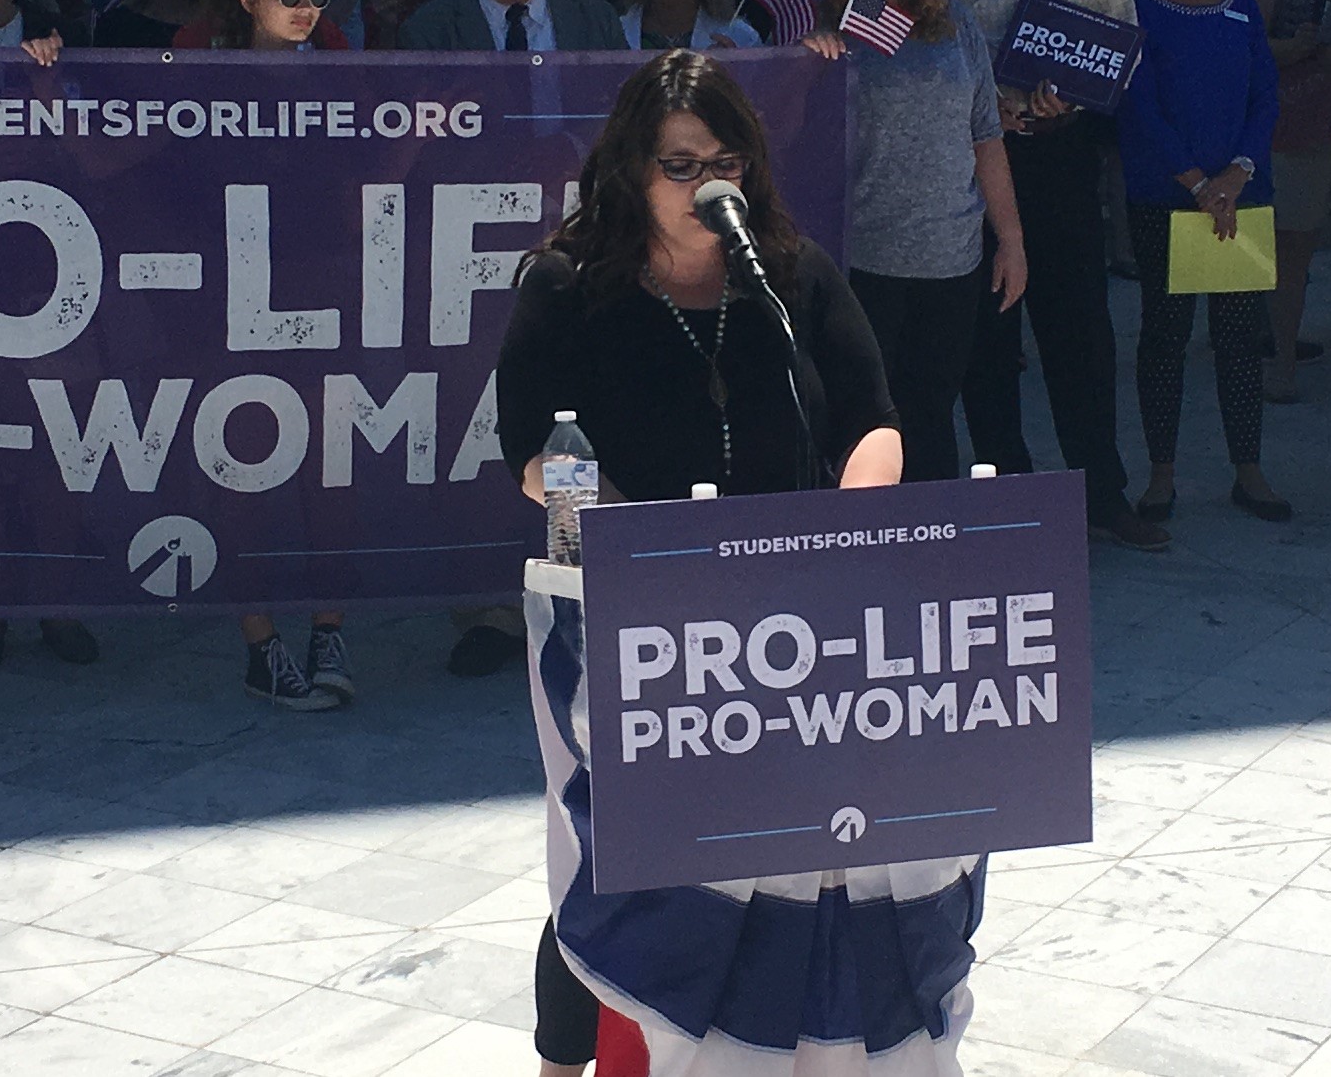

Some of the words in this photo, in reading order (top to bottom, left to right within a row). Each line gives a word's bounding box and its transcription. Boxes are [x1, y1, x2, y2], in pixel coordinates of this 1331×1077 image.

[1012, 37, 1121, 80] PRO-WOMAN
[1017, 21, 1126, 69] PRO-LIFE
[718, 524, 957, 557] STUDENTSFORLIFE.ORG
[618, 592, 1057, 701] PRO-LIFE
[621, 672, 1059, 763] PRO-WOMAN
